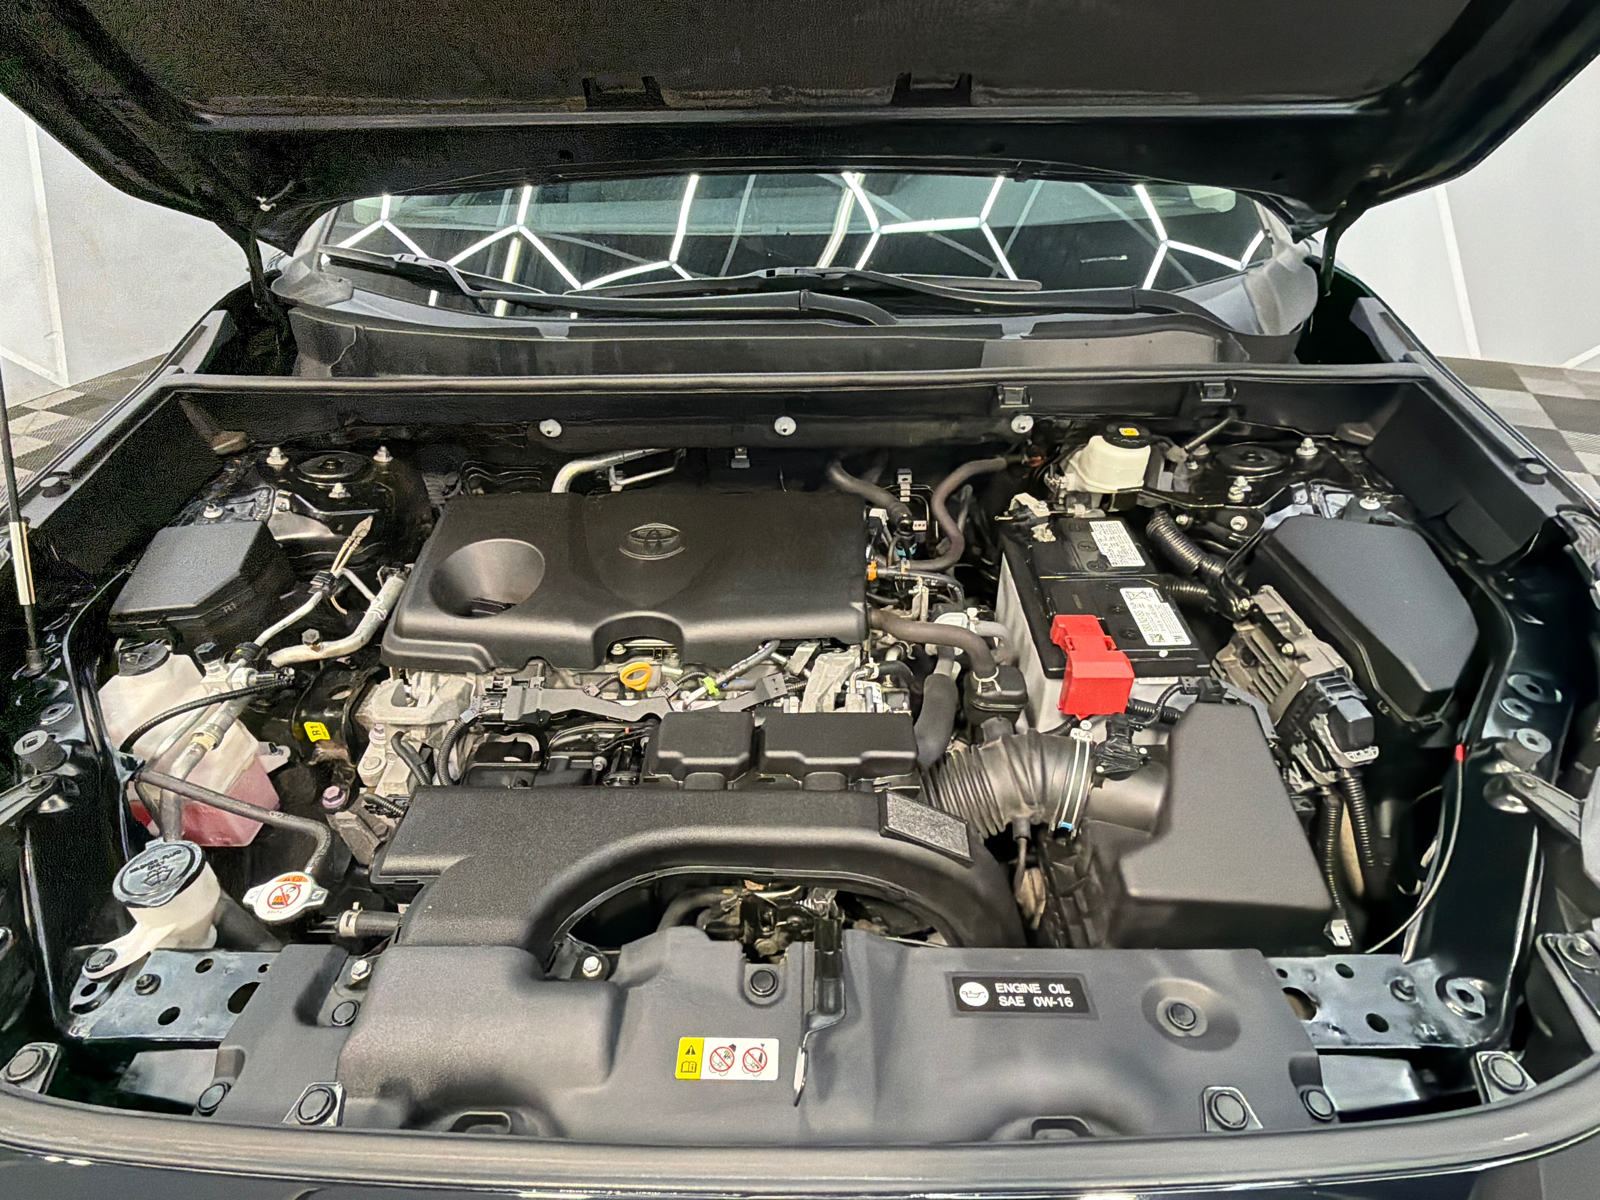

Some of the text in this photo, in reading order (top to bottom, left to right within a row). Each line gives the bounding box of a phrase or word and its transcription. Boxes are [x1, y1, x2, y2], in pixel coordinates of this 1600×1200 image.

[995, 982, 1071, 994] ENGINE OIL
[998, 996, 1074, 1007] SAE 0W-16
